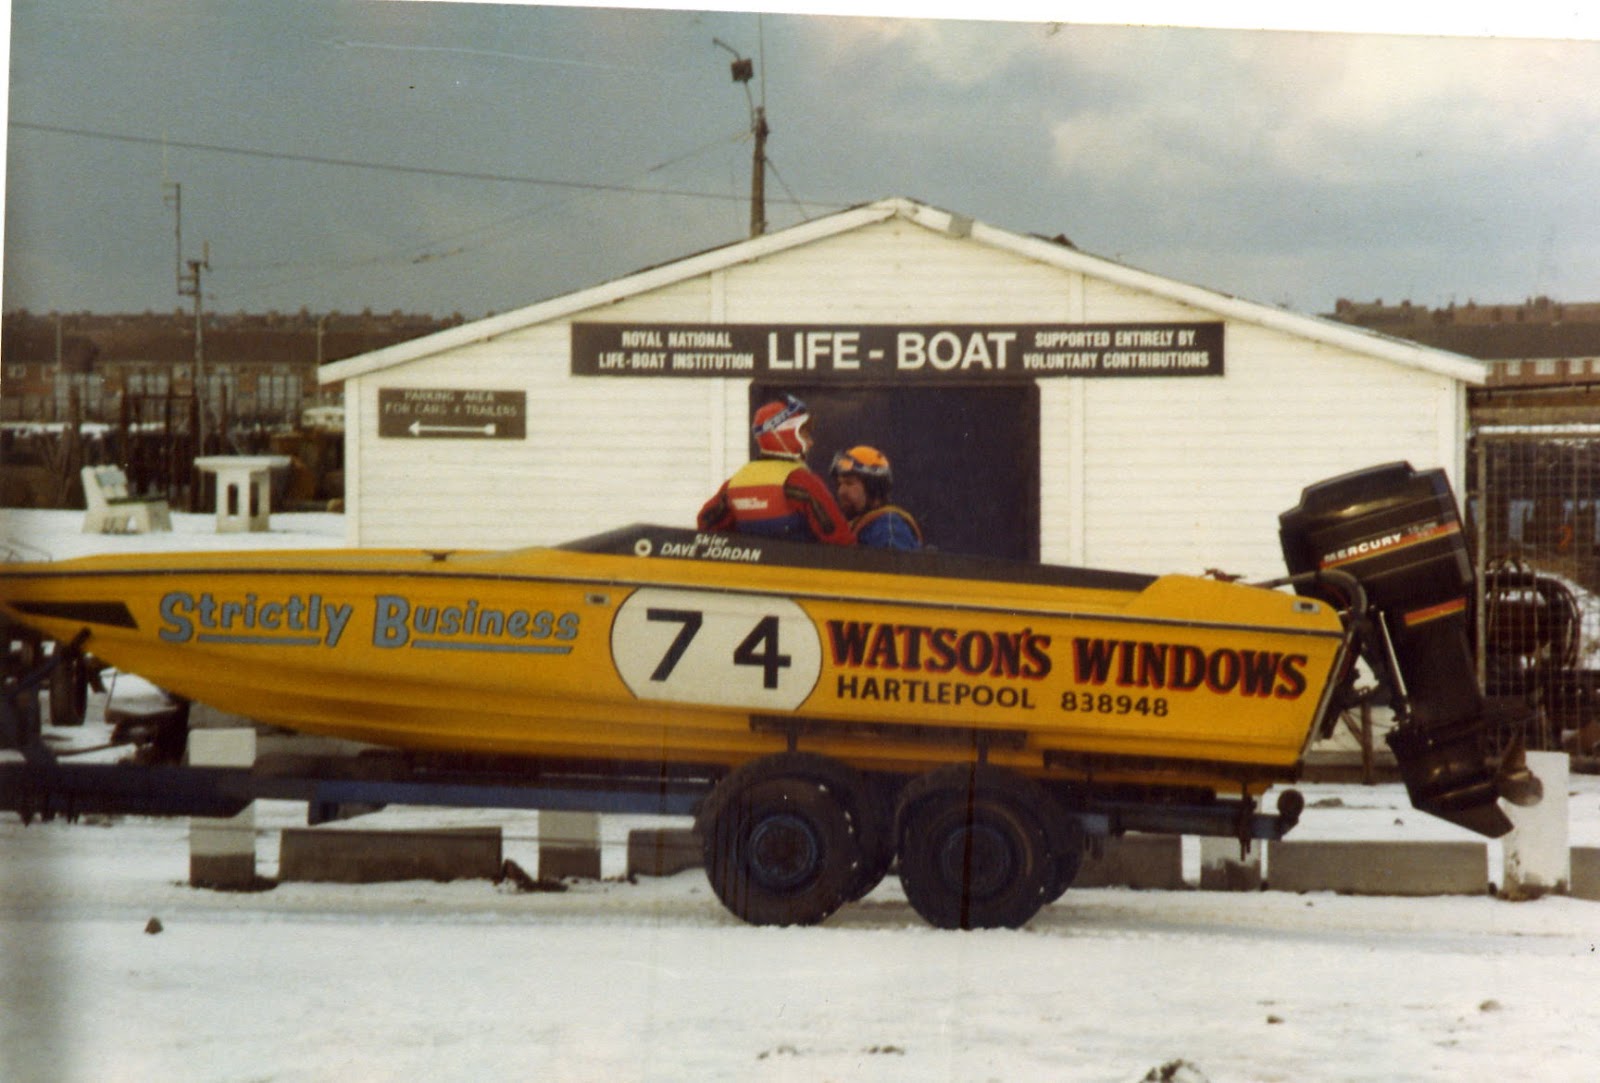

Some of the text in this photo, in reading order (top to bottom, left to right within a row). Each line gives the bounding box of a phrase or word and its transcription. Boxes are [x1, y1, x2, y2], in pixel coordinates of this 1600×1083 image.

[622, 331, 733, 348] ROYAL NATIONAL
[1035, 330, 1196, 348] SUPPORTED ENTIRELY BY
[599, 352, 754, 369] LIFE-BOAT INSTITUTION
[768, 332, 860, 369] LIFE
[897, 332, 1017, 370] BOAT
[1023, 351, 1210, 369] VOLUNTARY CONTRIBUTIONS
[385, 402, 411, 414] FOR
[695, 533, 729, 547] Skier
[1323, 532, 1401, 563] MERCURY
[660, 542, 762, 562] DAVE JORDAN
[158, 592, 580, 649] Strictly Business
[646, 608, 792, 689] 74
[826, 619, 1309, 701] WATSON'S WINDOWS
[836, 675, 1169, 718] HARTLEPOOL 838948
